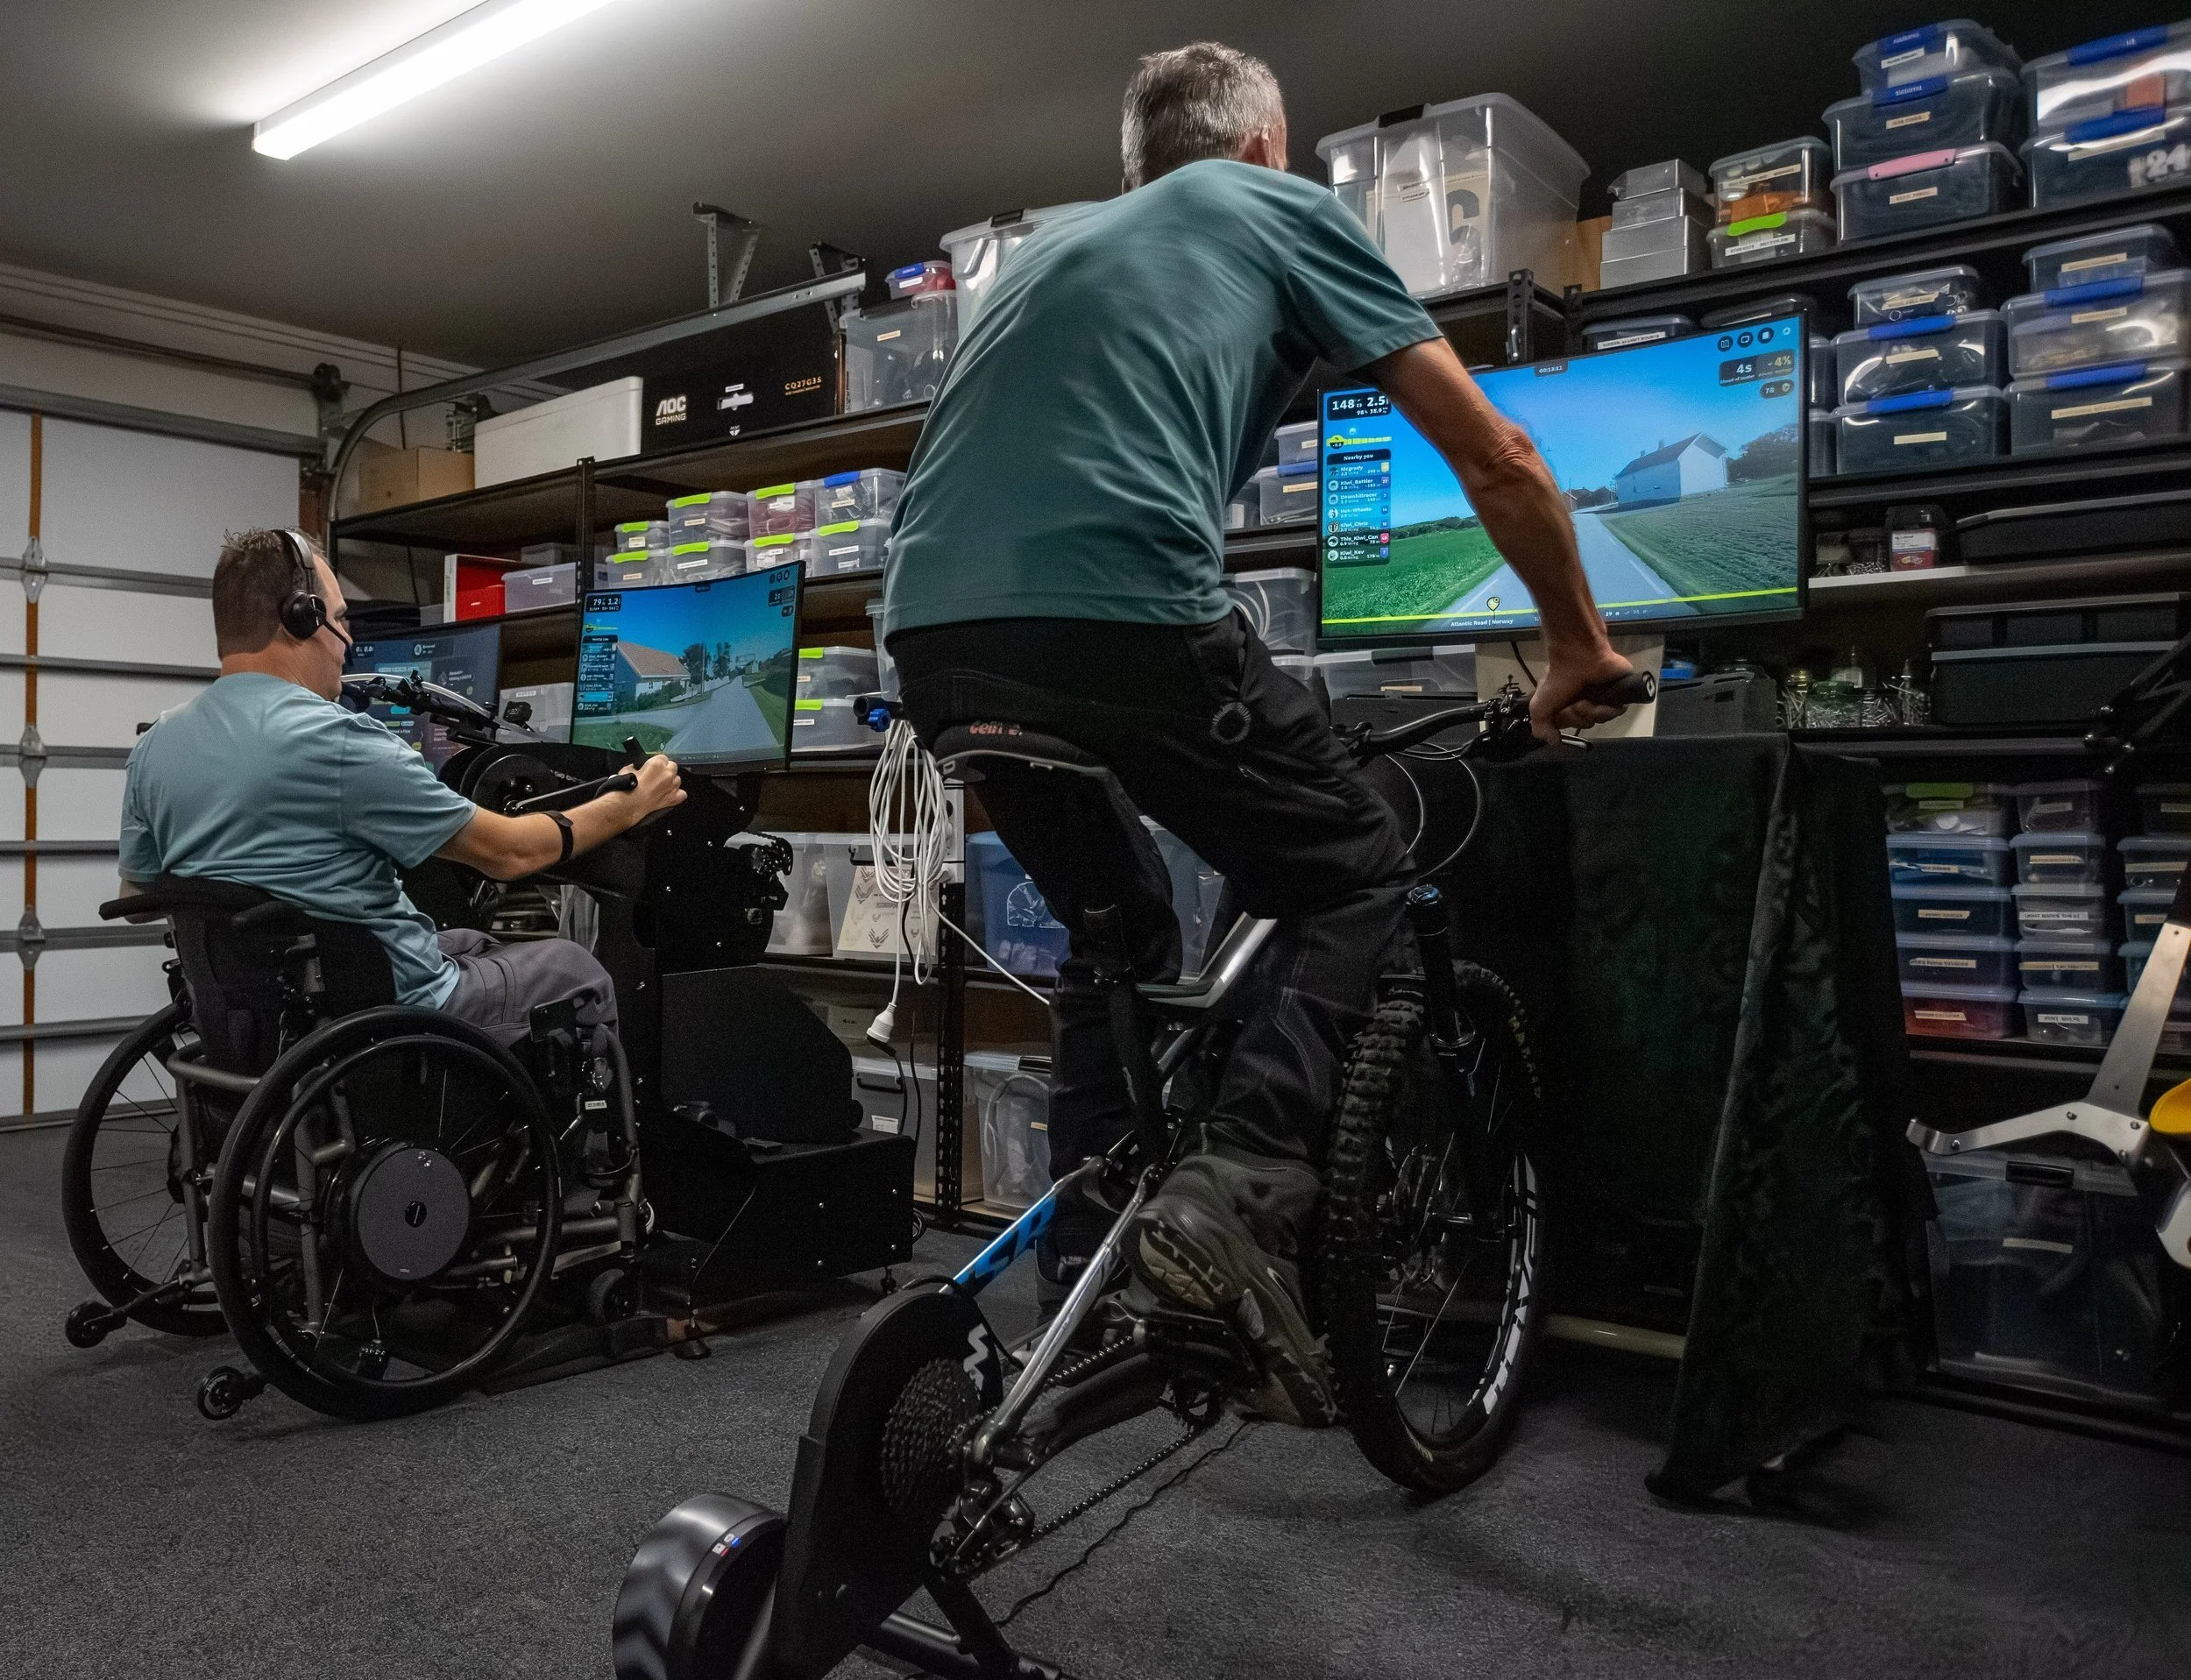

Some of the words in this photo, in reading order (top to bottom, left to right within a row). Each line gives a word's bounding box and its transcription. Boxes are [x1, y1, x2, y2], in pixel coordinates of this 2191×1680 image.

[1736, 364, 1752, 374] 4s
[656, 396, 687, 416] AOC
[1332, 399, 1355, 411] 148
[1366, 395, 1386, 407] 2.5
[656, 413, 686, 426] GAMING
